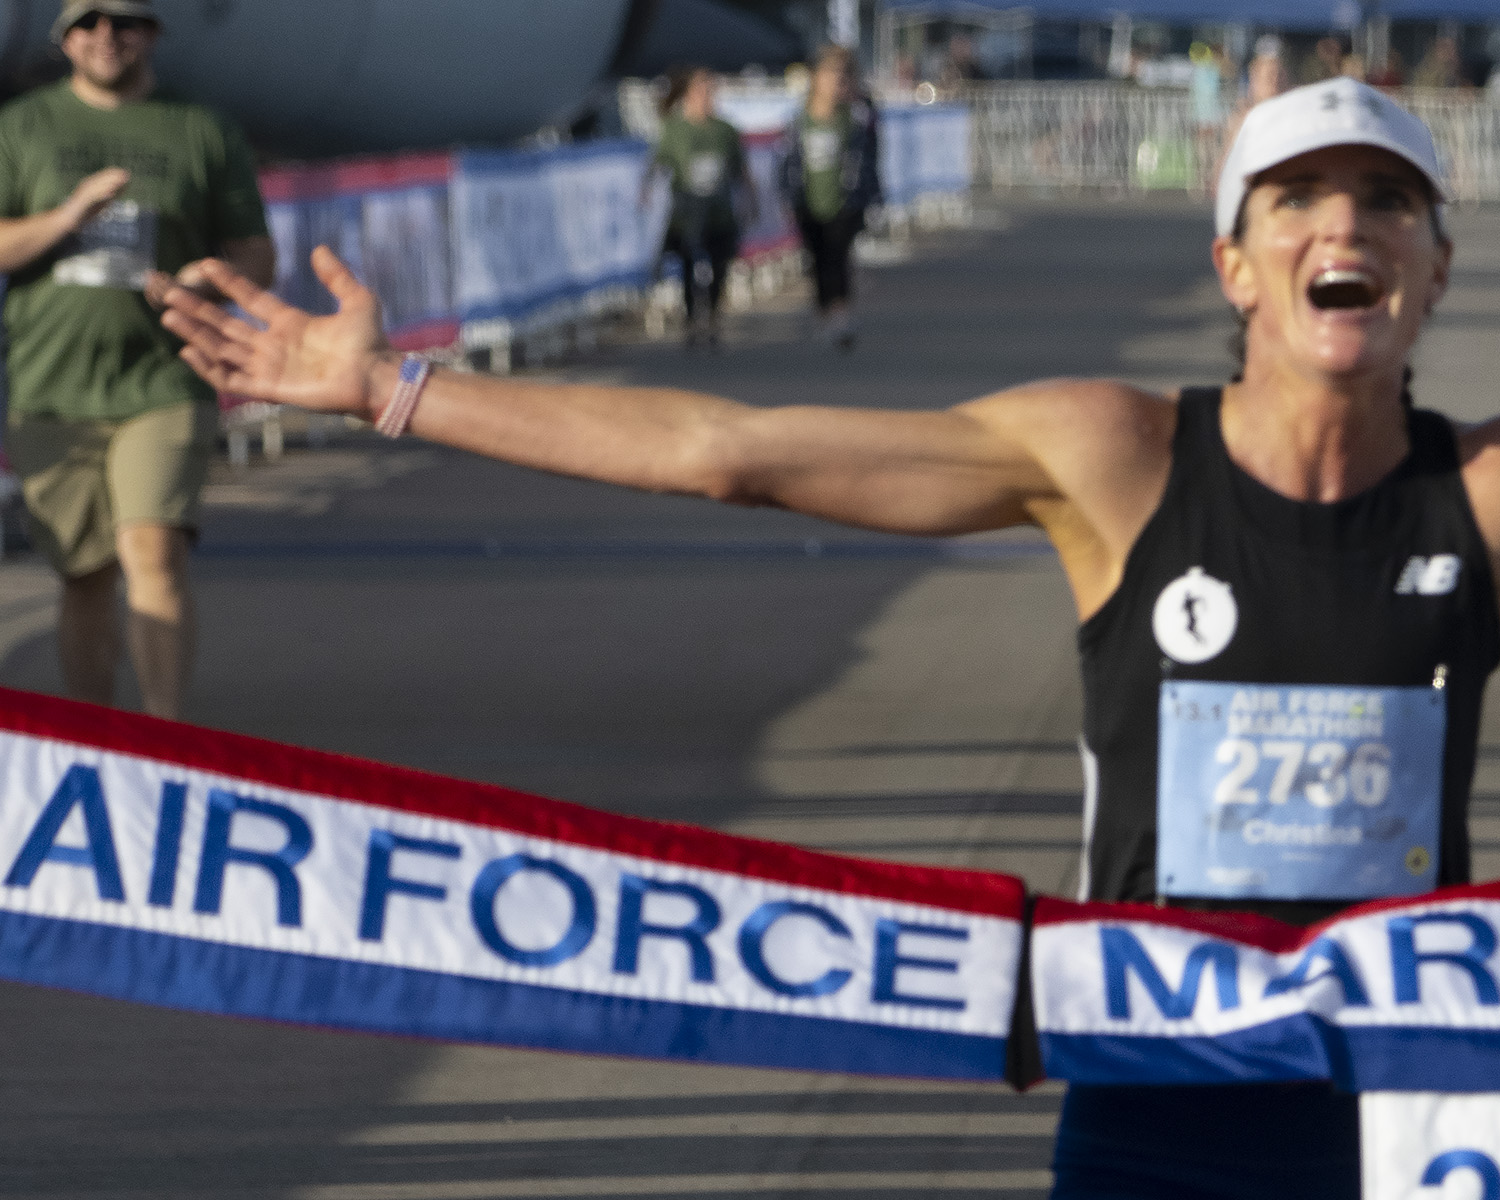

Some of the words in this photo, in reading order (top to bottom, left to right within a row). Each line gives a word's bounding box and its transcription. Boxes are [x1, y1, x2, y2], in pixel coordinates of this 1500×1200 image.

[1214, 739, 1392, 807] 2736
[3, 762, 315, 930] AIR
[357, 828, 970, 1012] FORCE
